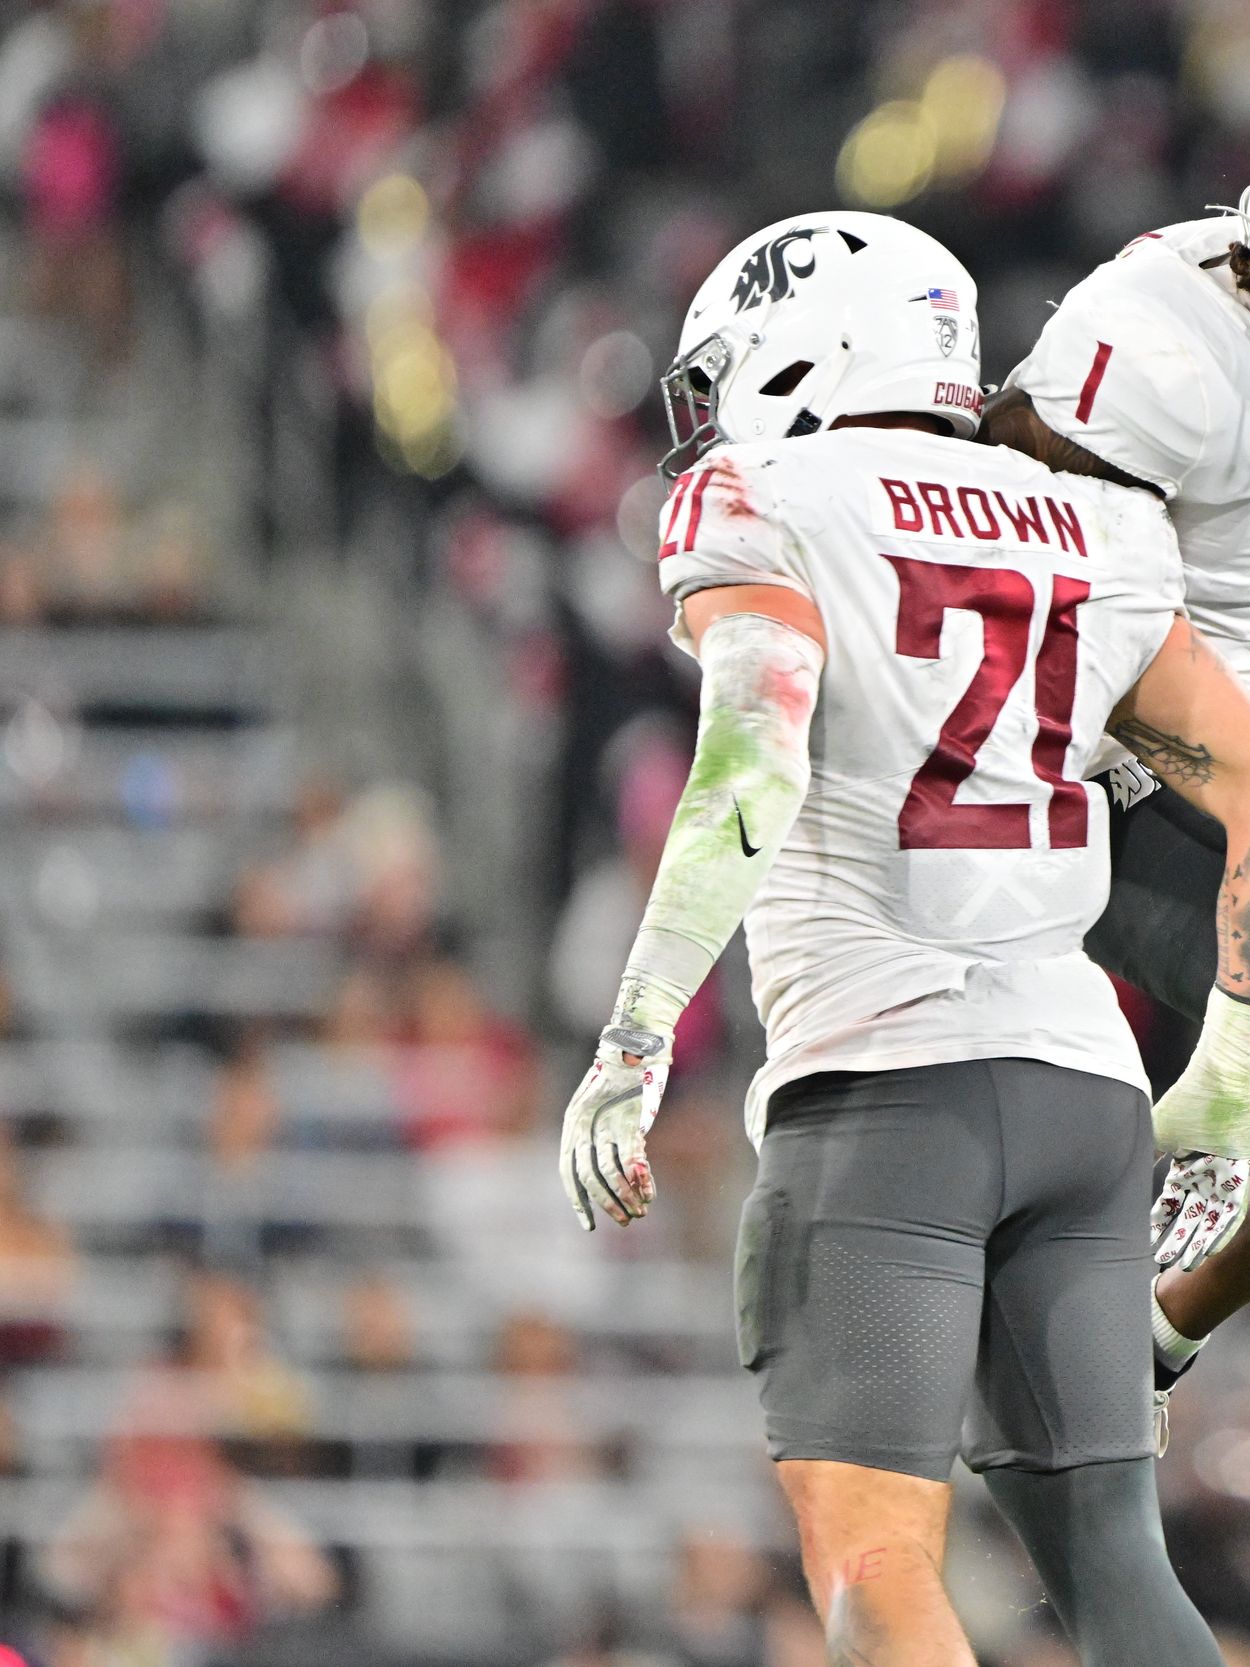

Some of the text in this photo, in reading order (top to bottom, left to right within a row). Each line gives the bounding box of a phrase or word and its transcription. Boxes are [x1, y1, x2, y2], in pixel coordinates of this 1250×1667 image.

[1075, 341, 1113, 425] 1
[657, 468, 714, 561] 21
[879, 477, 1088, 557] BROWN
[878, 553, 1091, 850] 21
[1221, 1175, 1245, 1192] WSU
